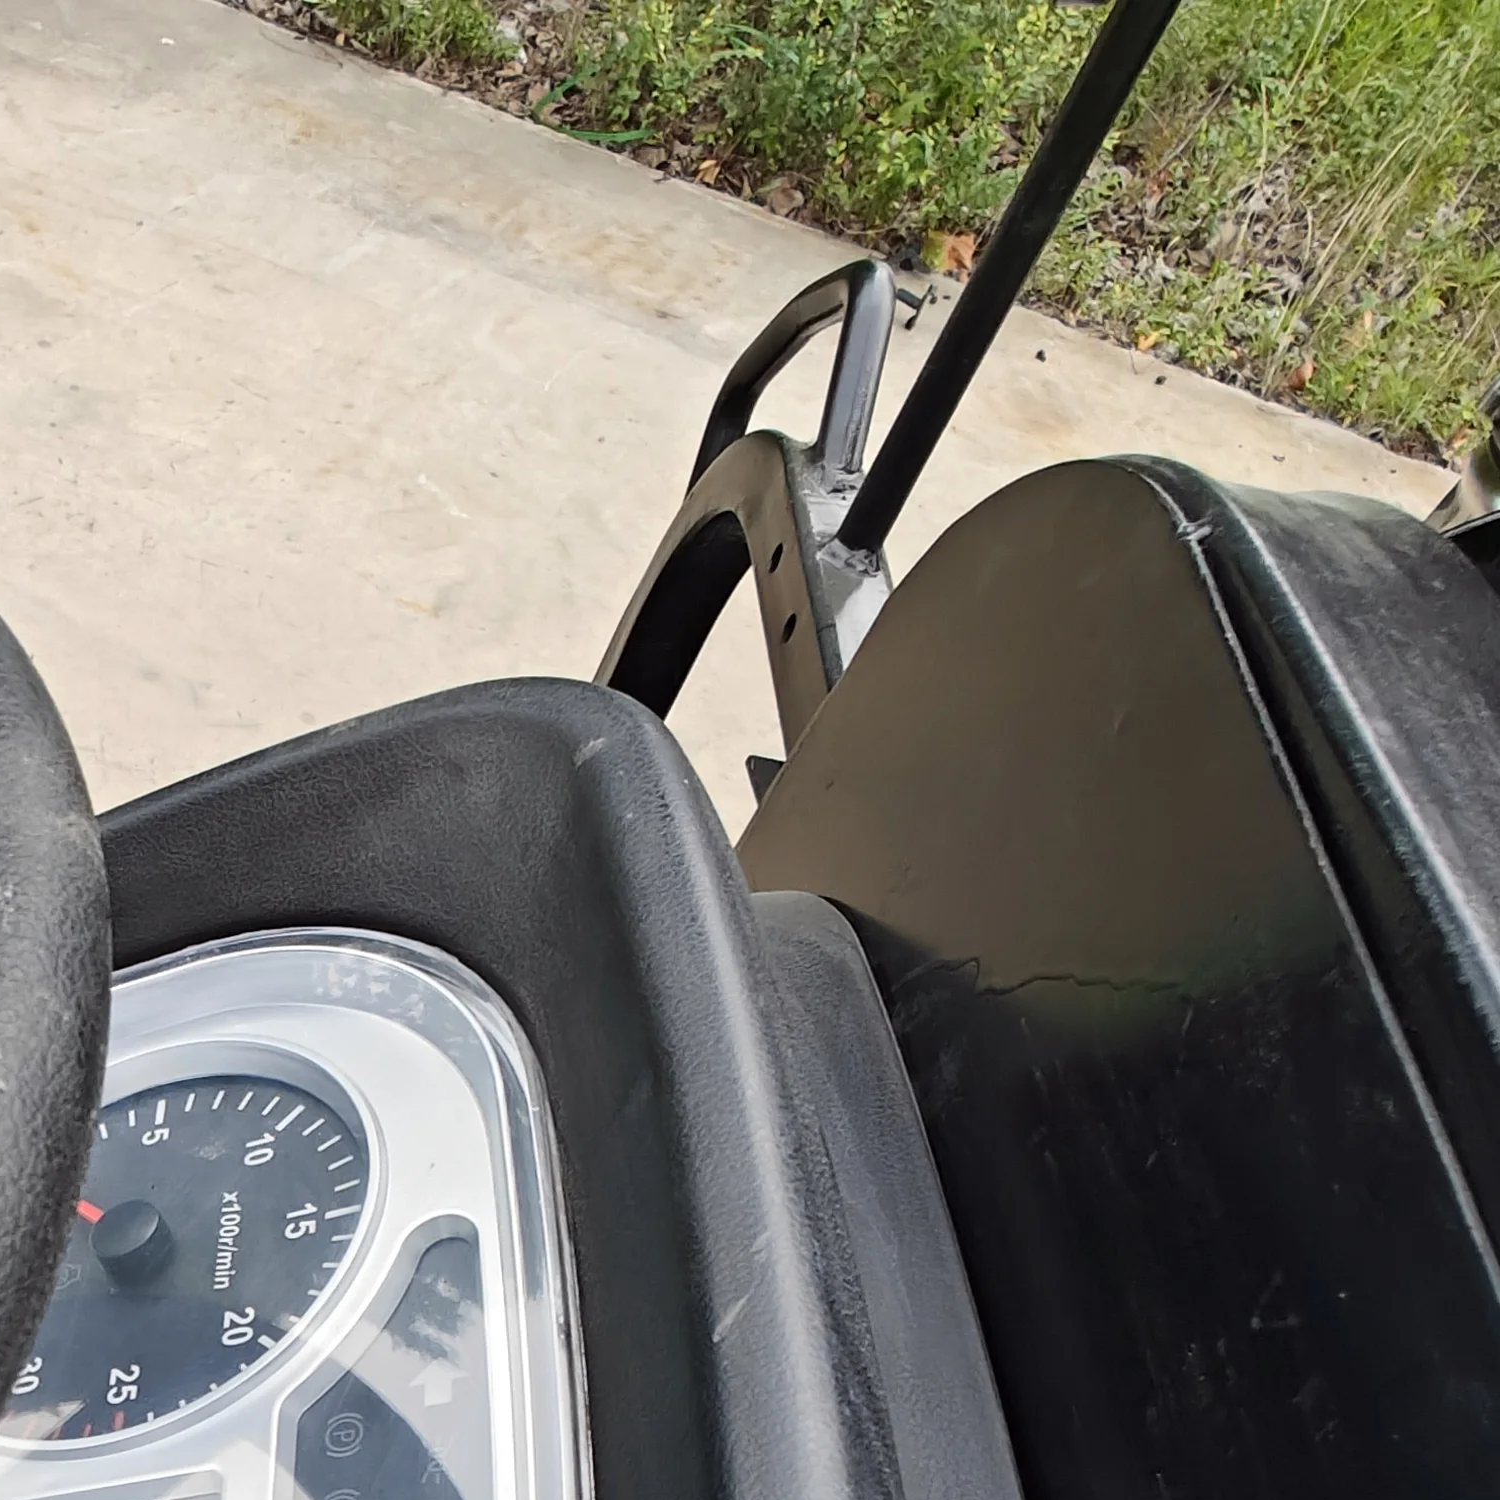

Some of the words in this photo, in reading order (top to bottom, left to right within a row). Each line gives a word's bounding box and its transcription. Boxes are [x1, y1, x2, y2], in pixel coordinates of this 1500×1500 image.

[141, 1128, 170, 1146] 5
[243, 1133, 275, 1167] 10
[284, 1202, 318, 1240] 15
[213, 1191, 243, 1291] x100r/min
[221, 1306, 255, 1347] 20
[106, 1364, 140, 1405] 25
